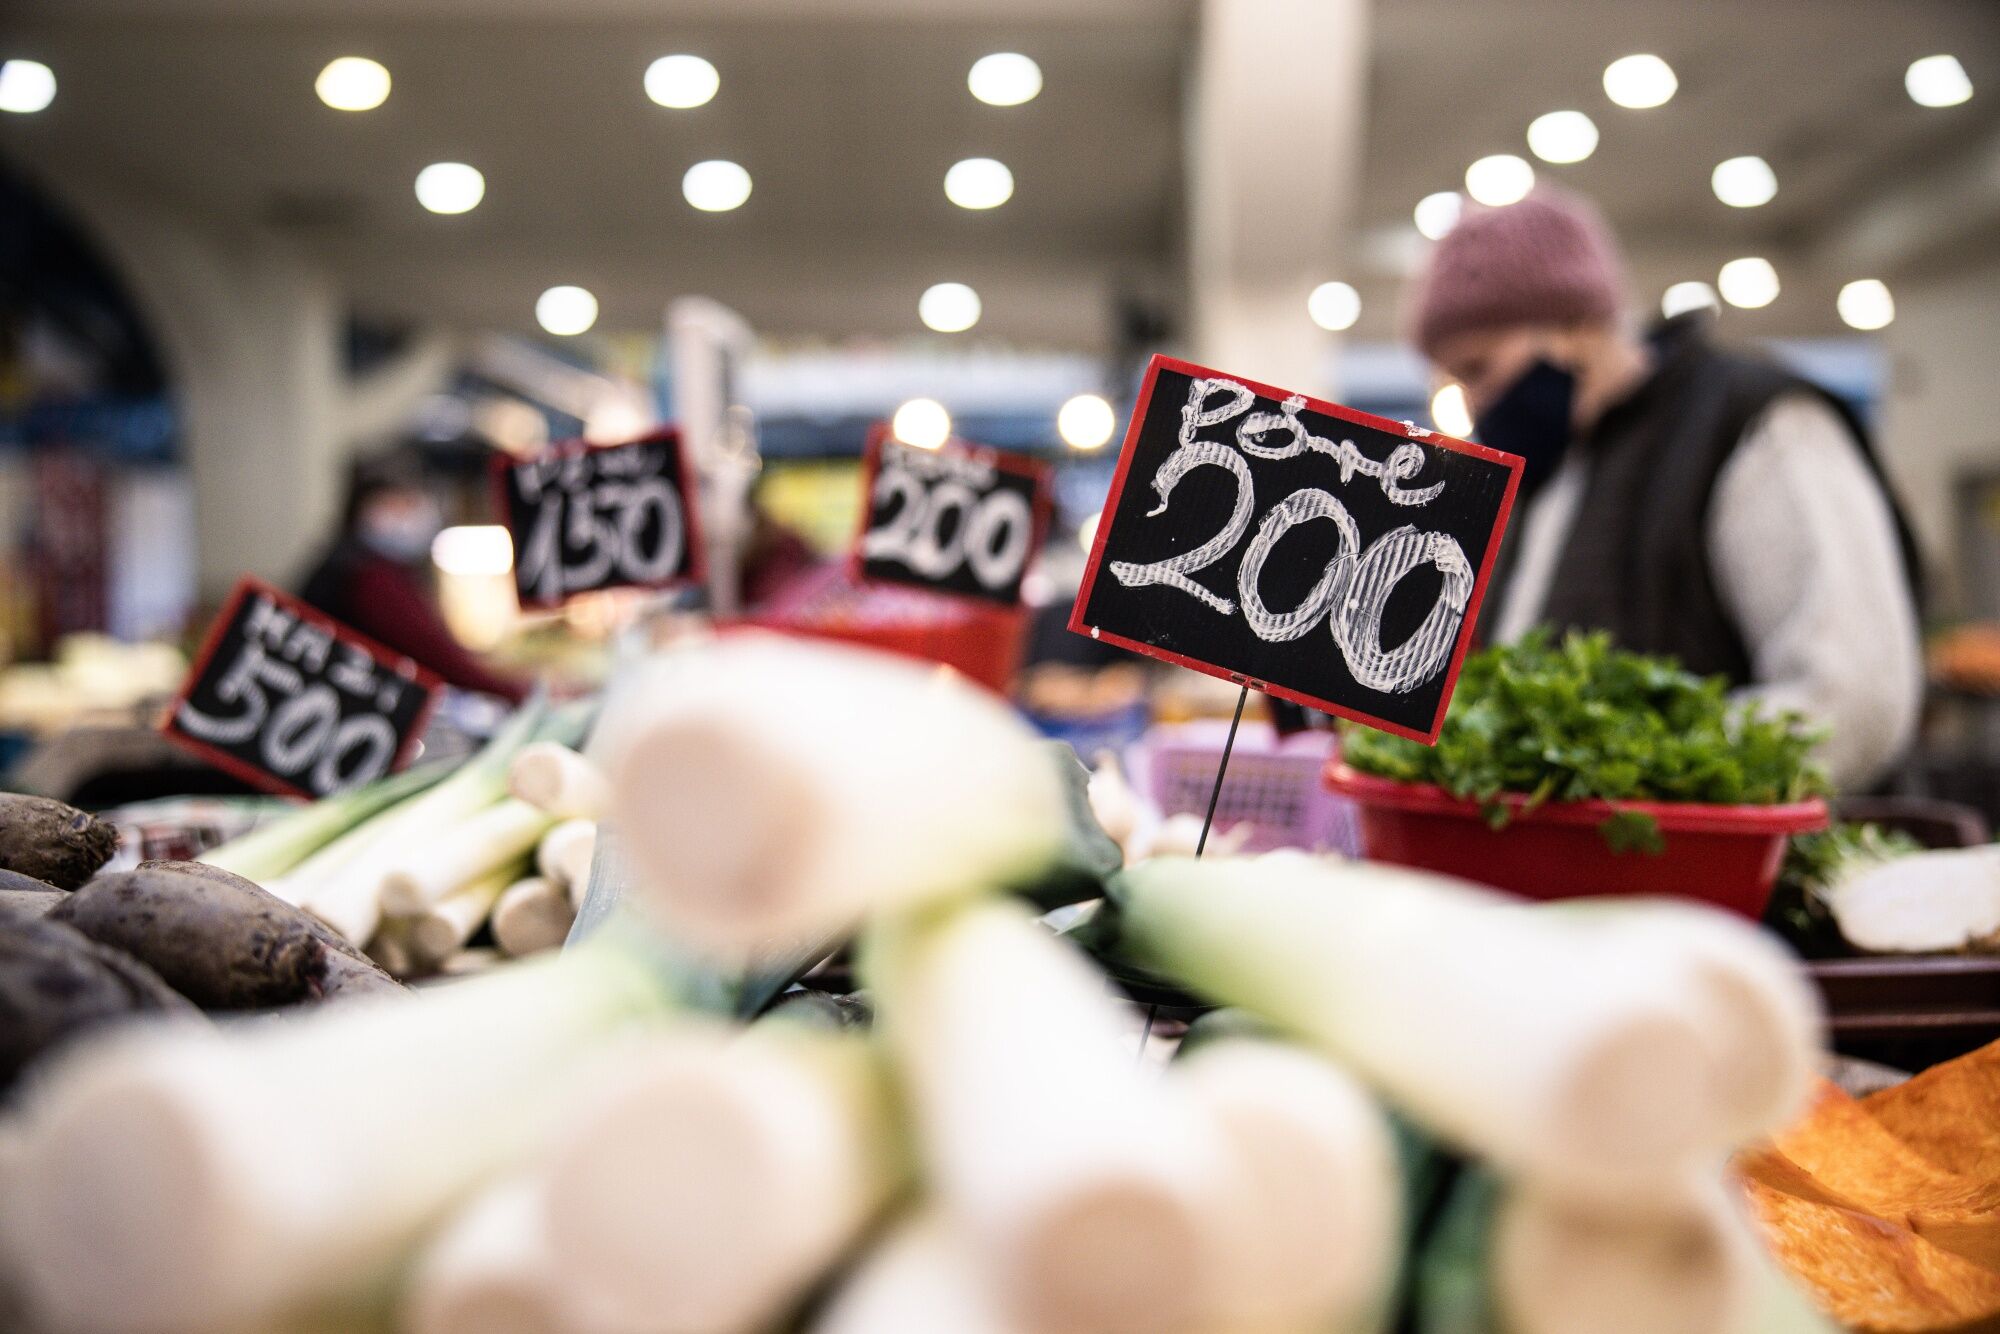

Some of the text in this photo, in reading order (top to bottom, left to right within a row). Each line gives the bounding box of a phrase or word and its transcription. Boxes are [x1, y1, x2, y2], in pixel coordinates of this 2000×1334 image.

[518, 477, 685, 602] 150
[862, 470, 1034, 590] 200
[1109, 441, 1475, 694] 200
[178, 640, 398, 797] 500
